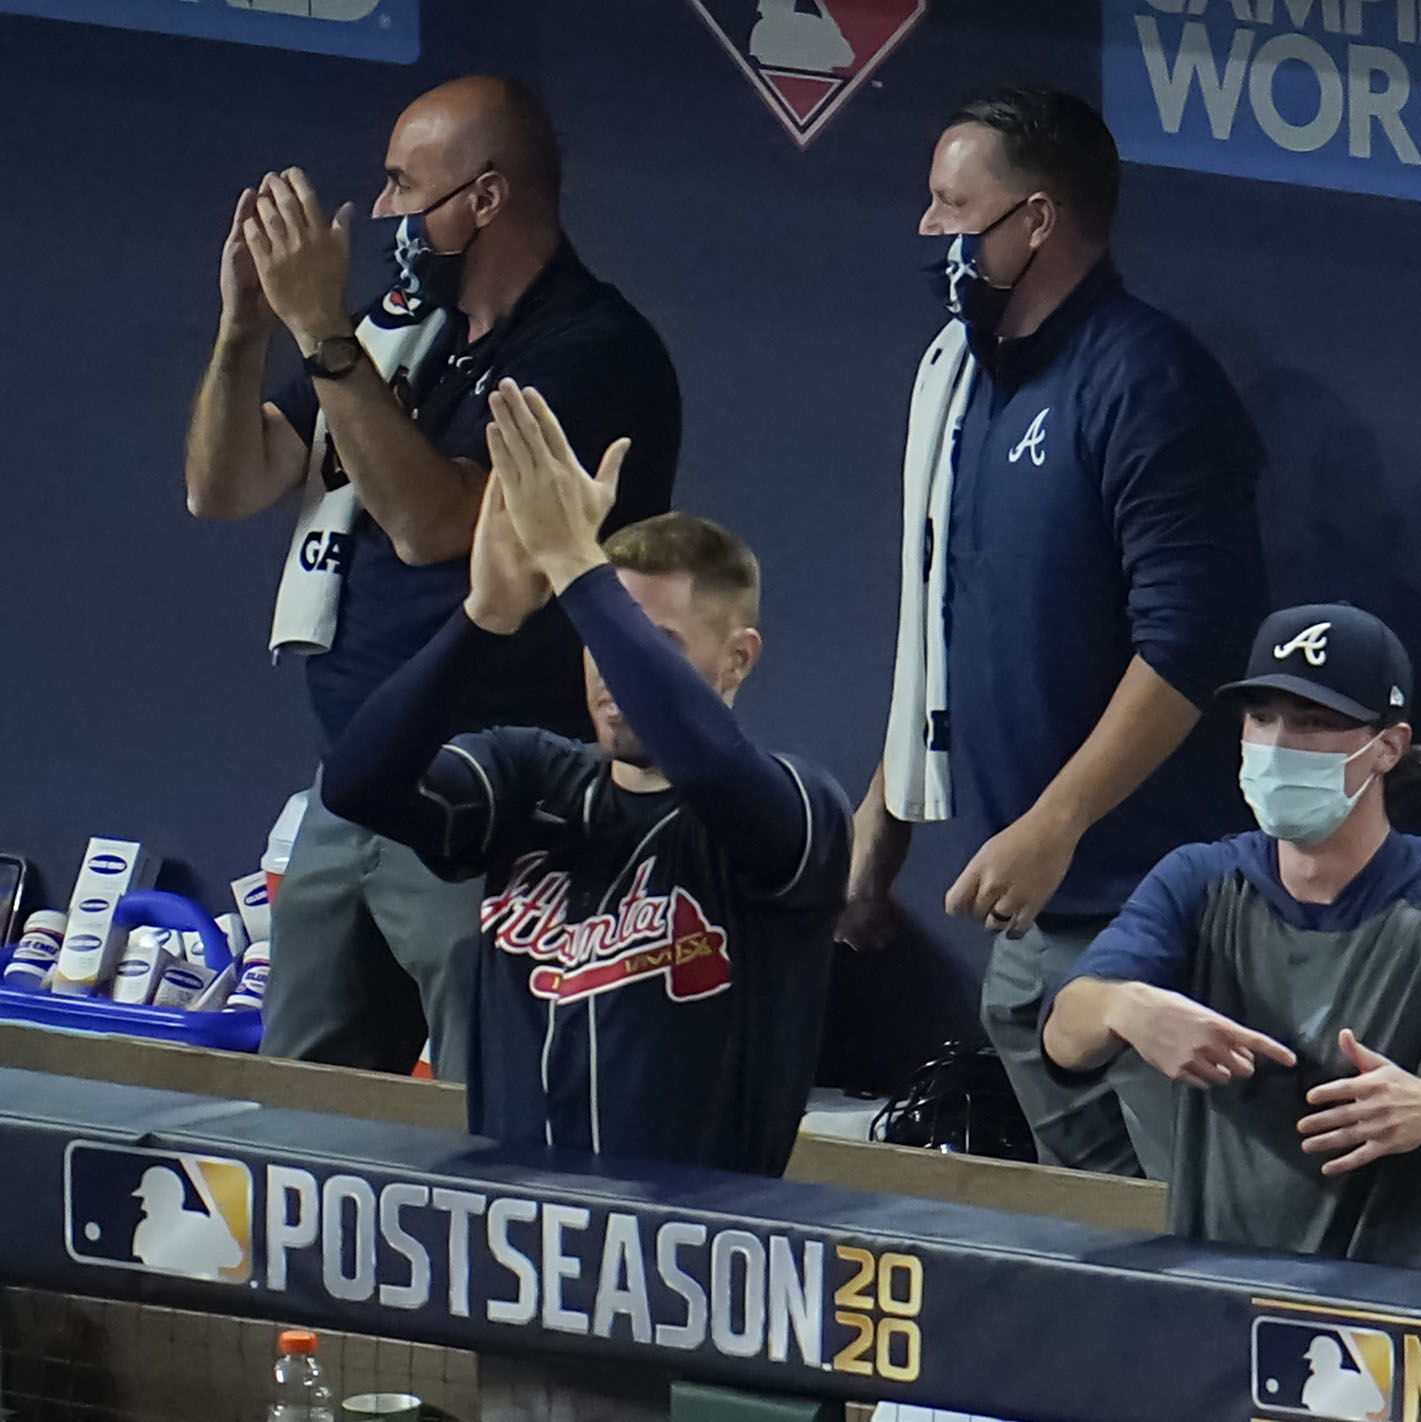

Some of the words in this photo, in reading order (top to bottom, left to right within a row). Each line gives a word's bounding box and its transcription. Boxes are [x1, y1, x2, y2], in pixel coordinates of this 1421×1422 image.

[1273, 622, 1331, 666] A
[481, 850, 671, 966] Atlanta
[266, 1164, 824, 1368] POSTSEASON
